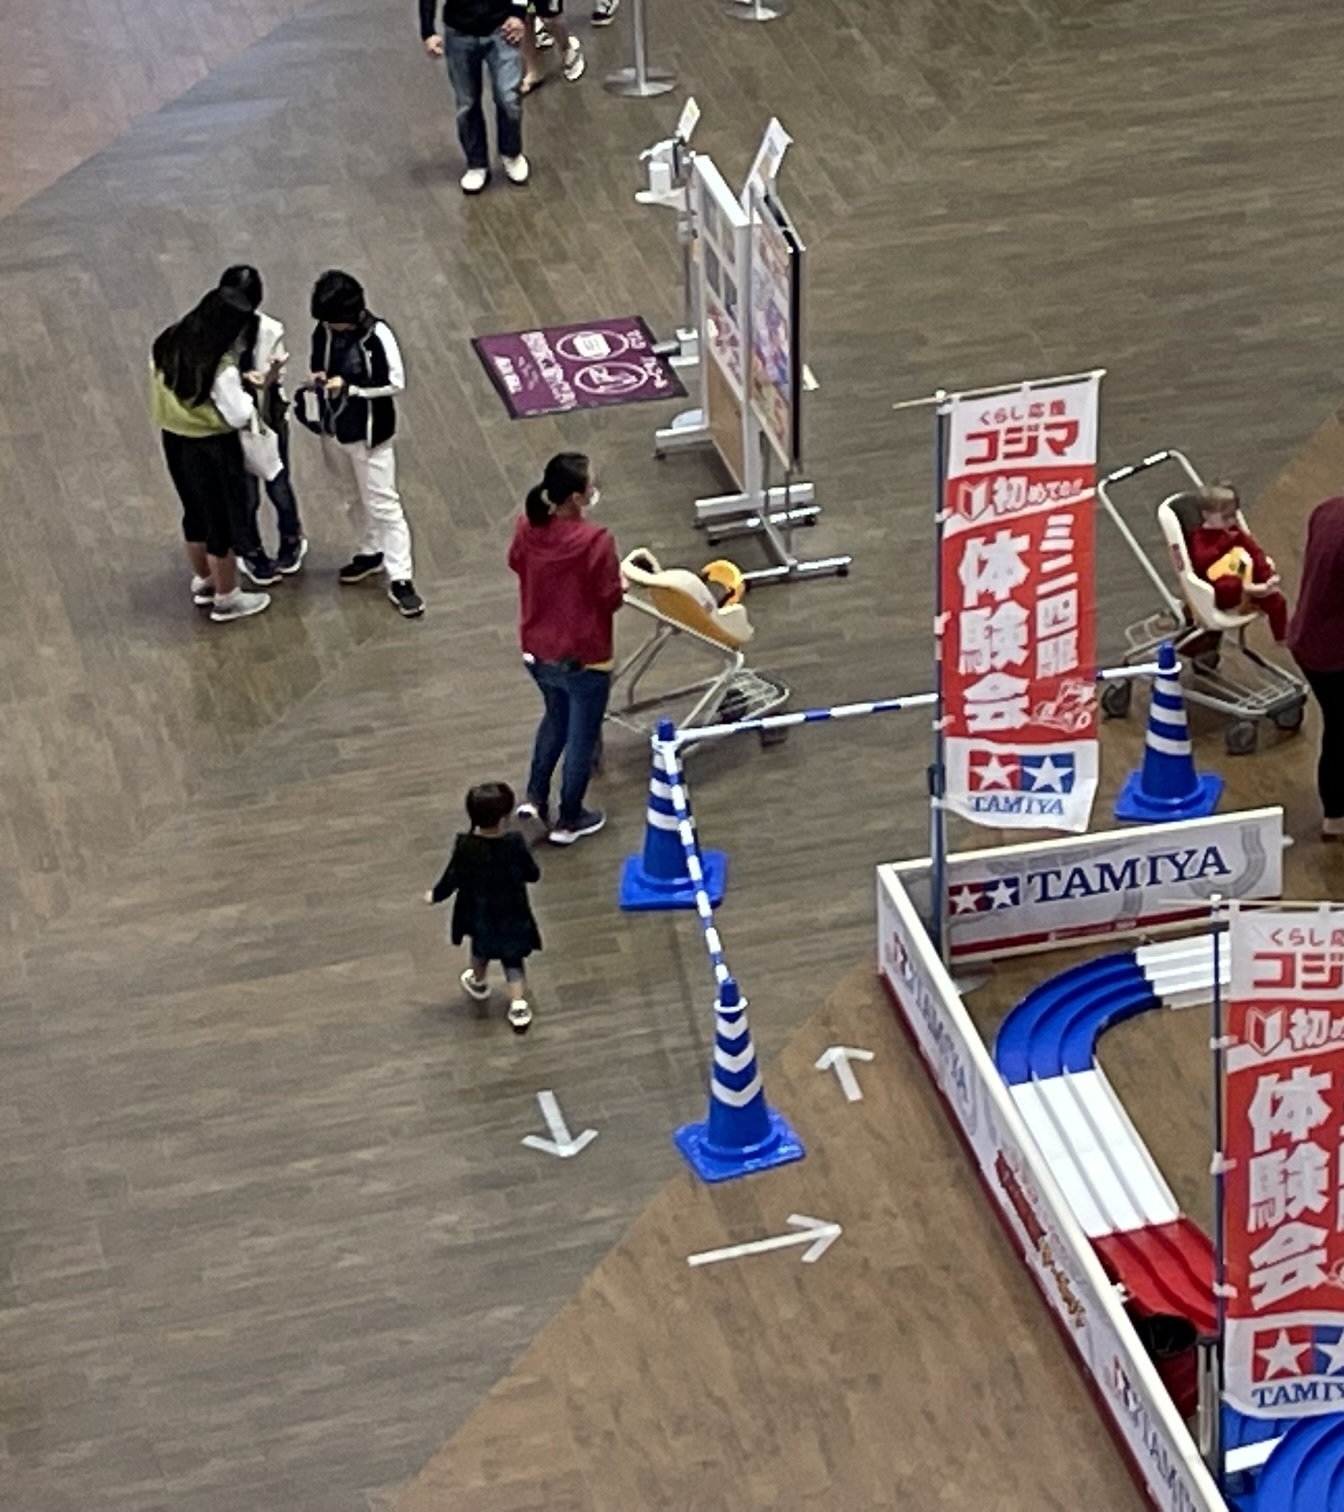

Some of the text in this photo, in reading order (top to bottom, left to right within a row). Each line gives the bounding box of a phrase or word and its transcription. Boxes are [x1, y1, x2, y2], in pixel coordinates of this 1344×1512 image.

[964, 419, 1080, 467] コジマ
[958, 529, 1031, 734] 体験会
[970, 794, 1064, 816] TAMIYA
[1027, 845, 1231, 904] TAMIYA
[1247, 1064, 1333, 1311] 体験会
